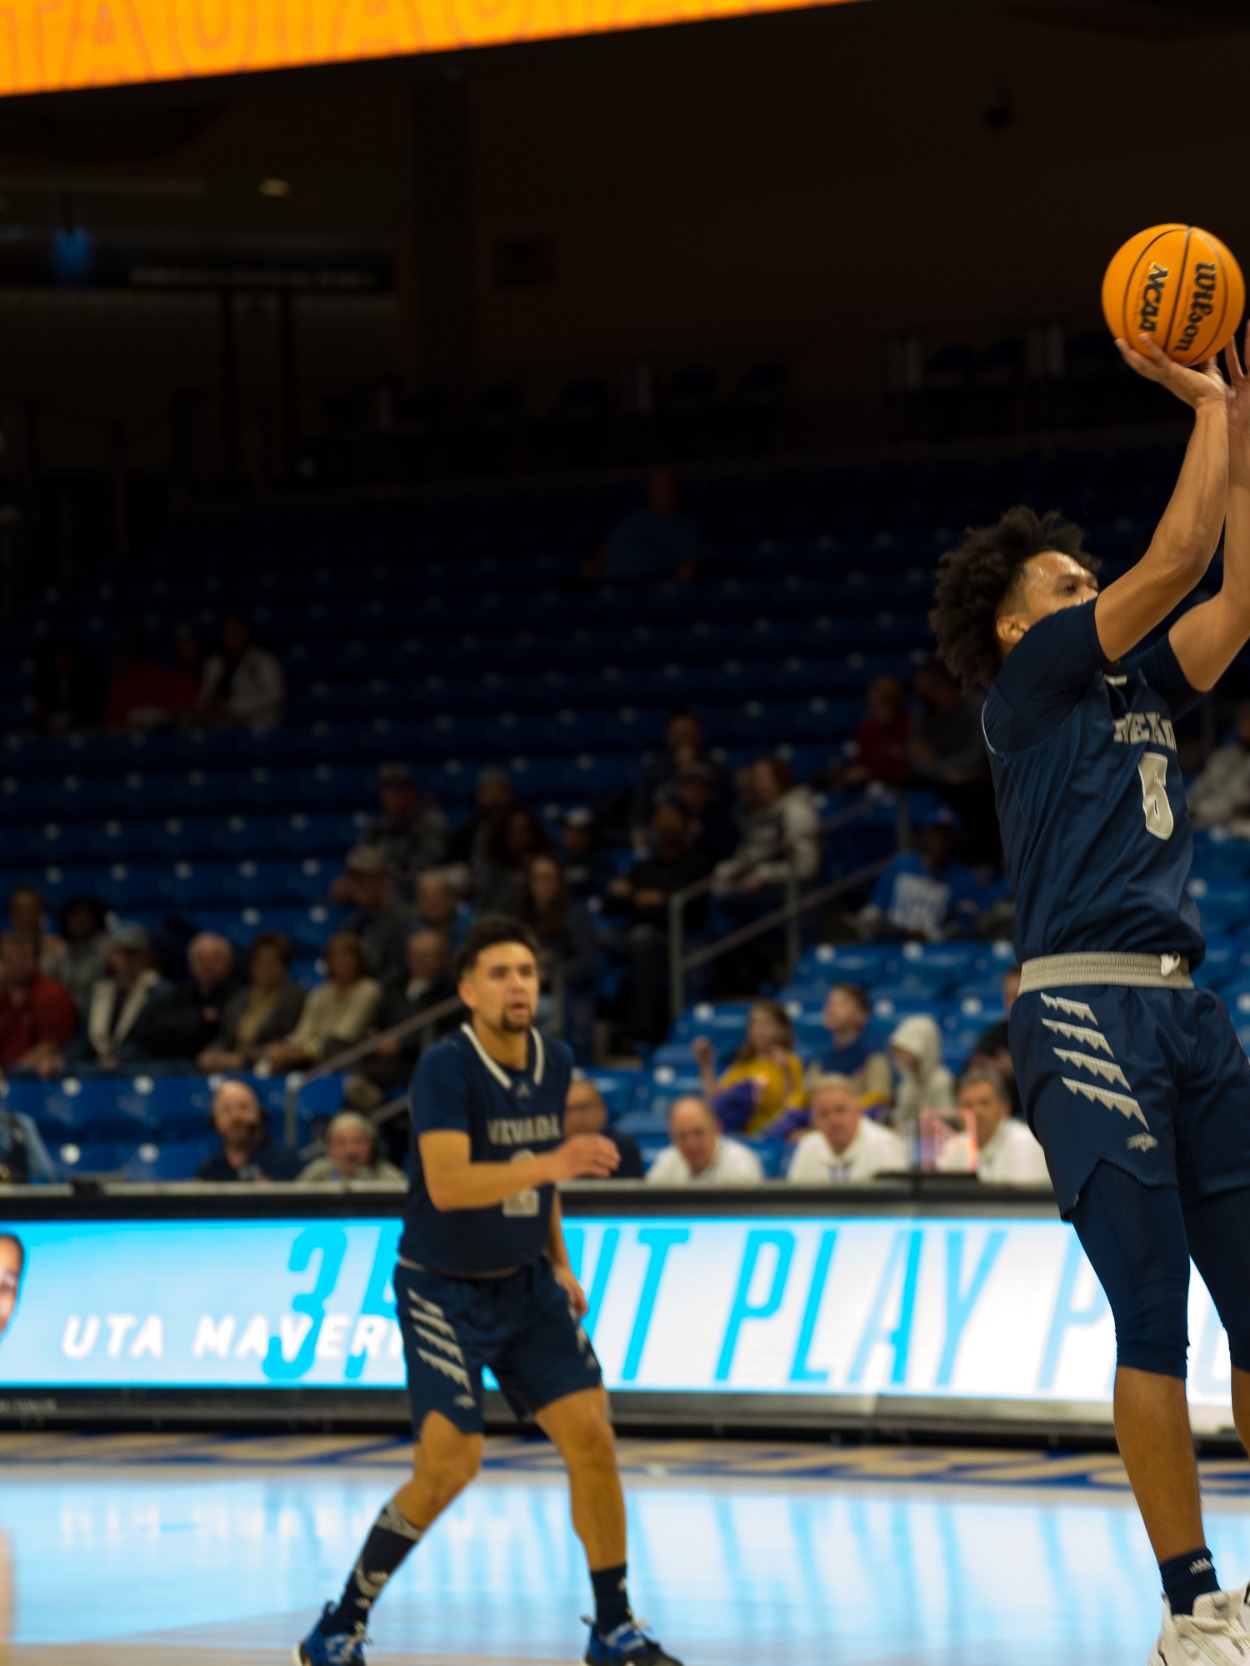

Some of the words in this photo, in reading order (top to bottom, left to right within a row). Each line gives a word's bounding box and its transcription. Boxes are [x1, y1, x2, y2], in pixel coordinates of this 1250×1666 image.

[1173, 262, 1216, 352] Wilson
[487, 1115, 561, 1146] NEVADA
[62, 1313, 163, 1359] UTA
[715, 1229, 1007, 1387] PLAY
